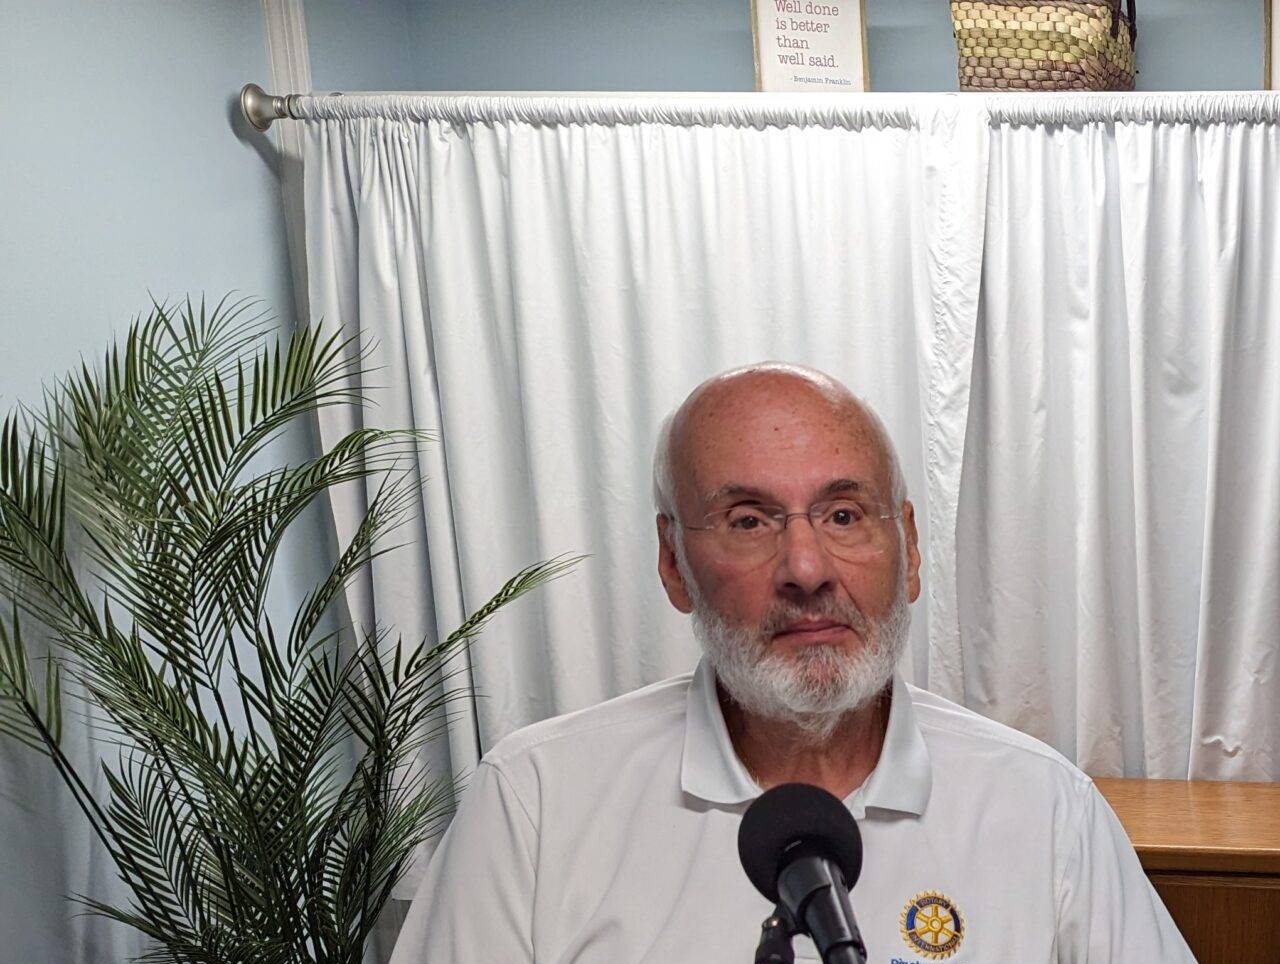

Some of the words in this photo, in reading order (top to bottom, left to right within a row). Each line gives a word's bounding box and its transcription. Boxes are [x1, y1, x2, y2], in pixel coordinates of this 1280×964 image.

[775, 0, 802, 13] Well
[805, 2, 839, 16] done
[776, 17, 787, 31] is
[789, 18, 830, 33] better
[776, 35, 810, 49] than
[778, 53, 805, 66] well
[808, 55, 840, 68] said.
[824, 77, 852, 85] Franklin
